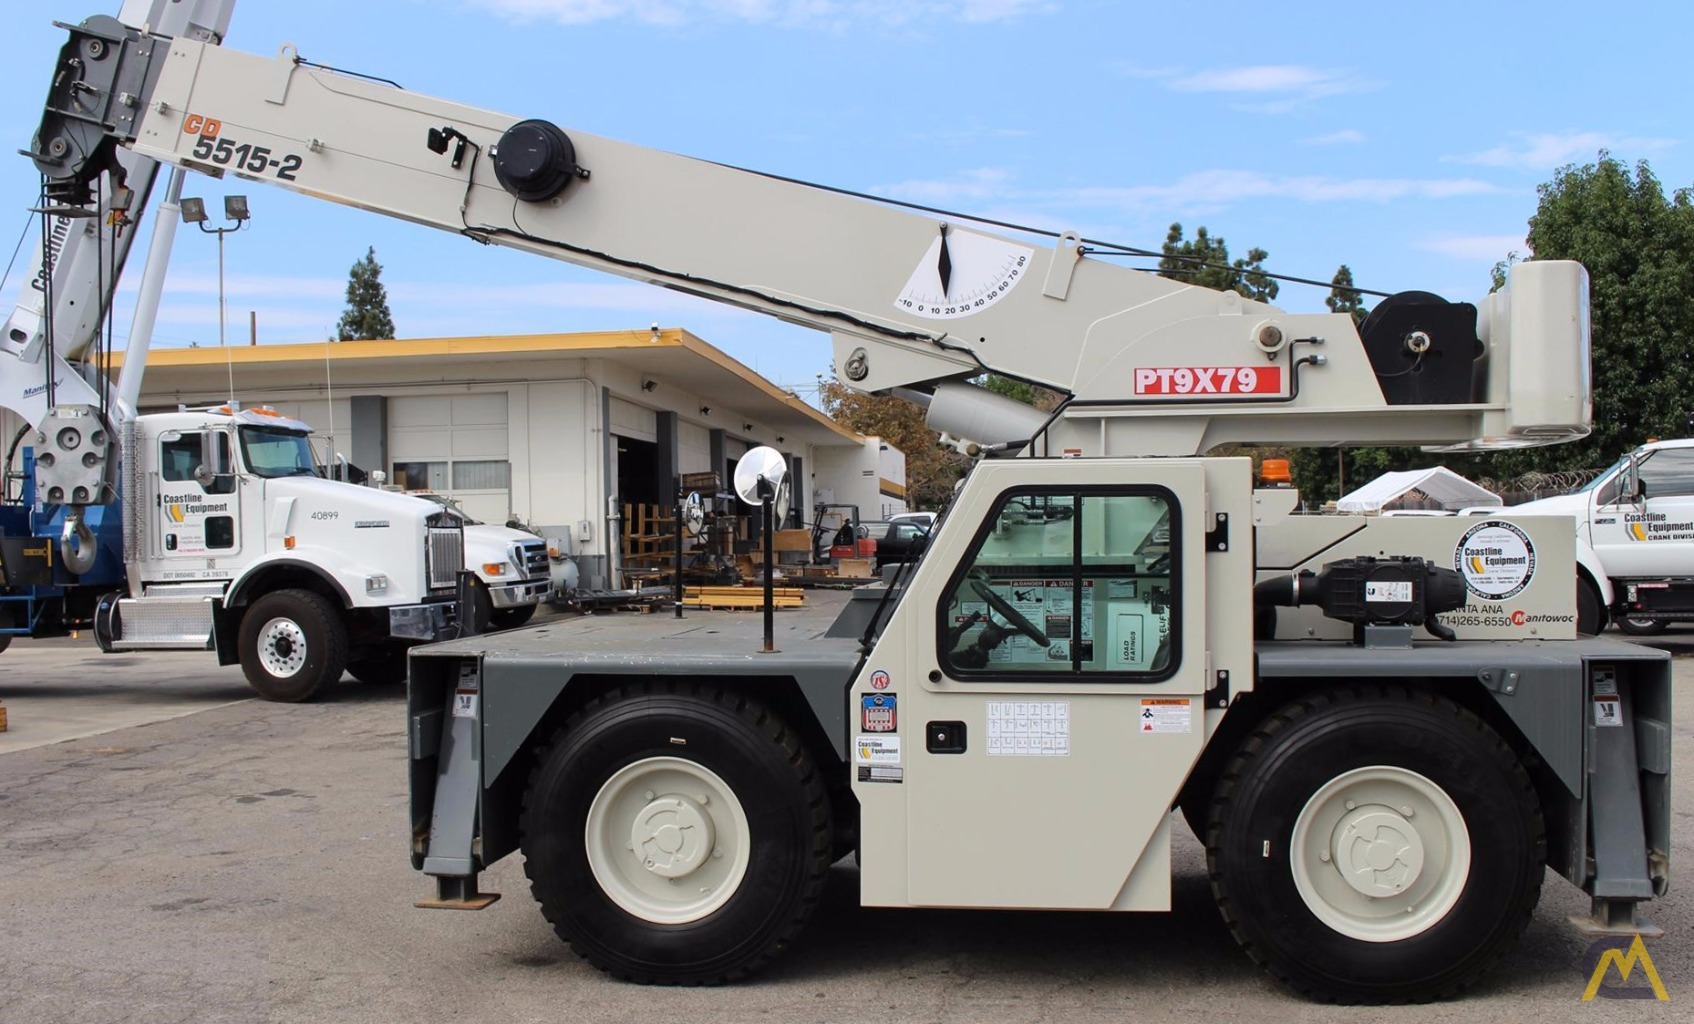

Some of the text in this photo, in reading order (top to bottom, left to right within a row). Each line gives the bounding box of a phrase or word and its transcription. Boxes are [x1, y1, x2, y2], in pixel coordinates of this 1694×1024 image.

[184, 114, 222, 137] CD
[193, 134, 303, 181] 5515-2
[959, 304, 971, 313] 30
[974, 298, 985, 308] 40
[987, 291, 998, 301] 50
[998, 281, 1009, 292] 60
[1008, 269, 1018, 281] 70
[1016, 255, 1026, 268] 80
[1136, 367, 1258, 394] PT9X79
[163, 493, 203, 504] Coastline
[185, 503, 228, 514] Equipment
[311, 511, 339, 520] 40899
[1624, 513, 1666, 522] Coastline
[1648, 522, 1693, 532] Equipment
[1464, 547, 1503, 556] Coastline
[1485, 556, 1526, 566] Equipment
[1453, 604, 1504, 614] NTA ANA
[1511, 610, 1574, 626] Manitowoc
